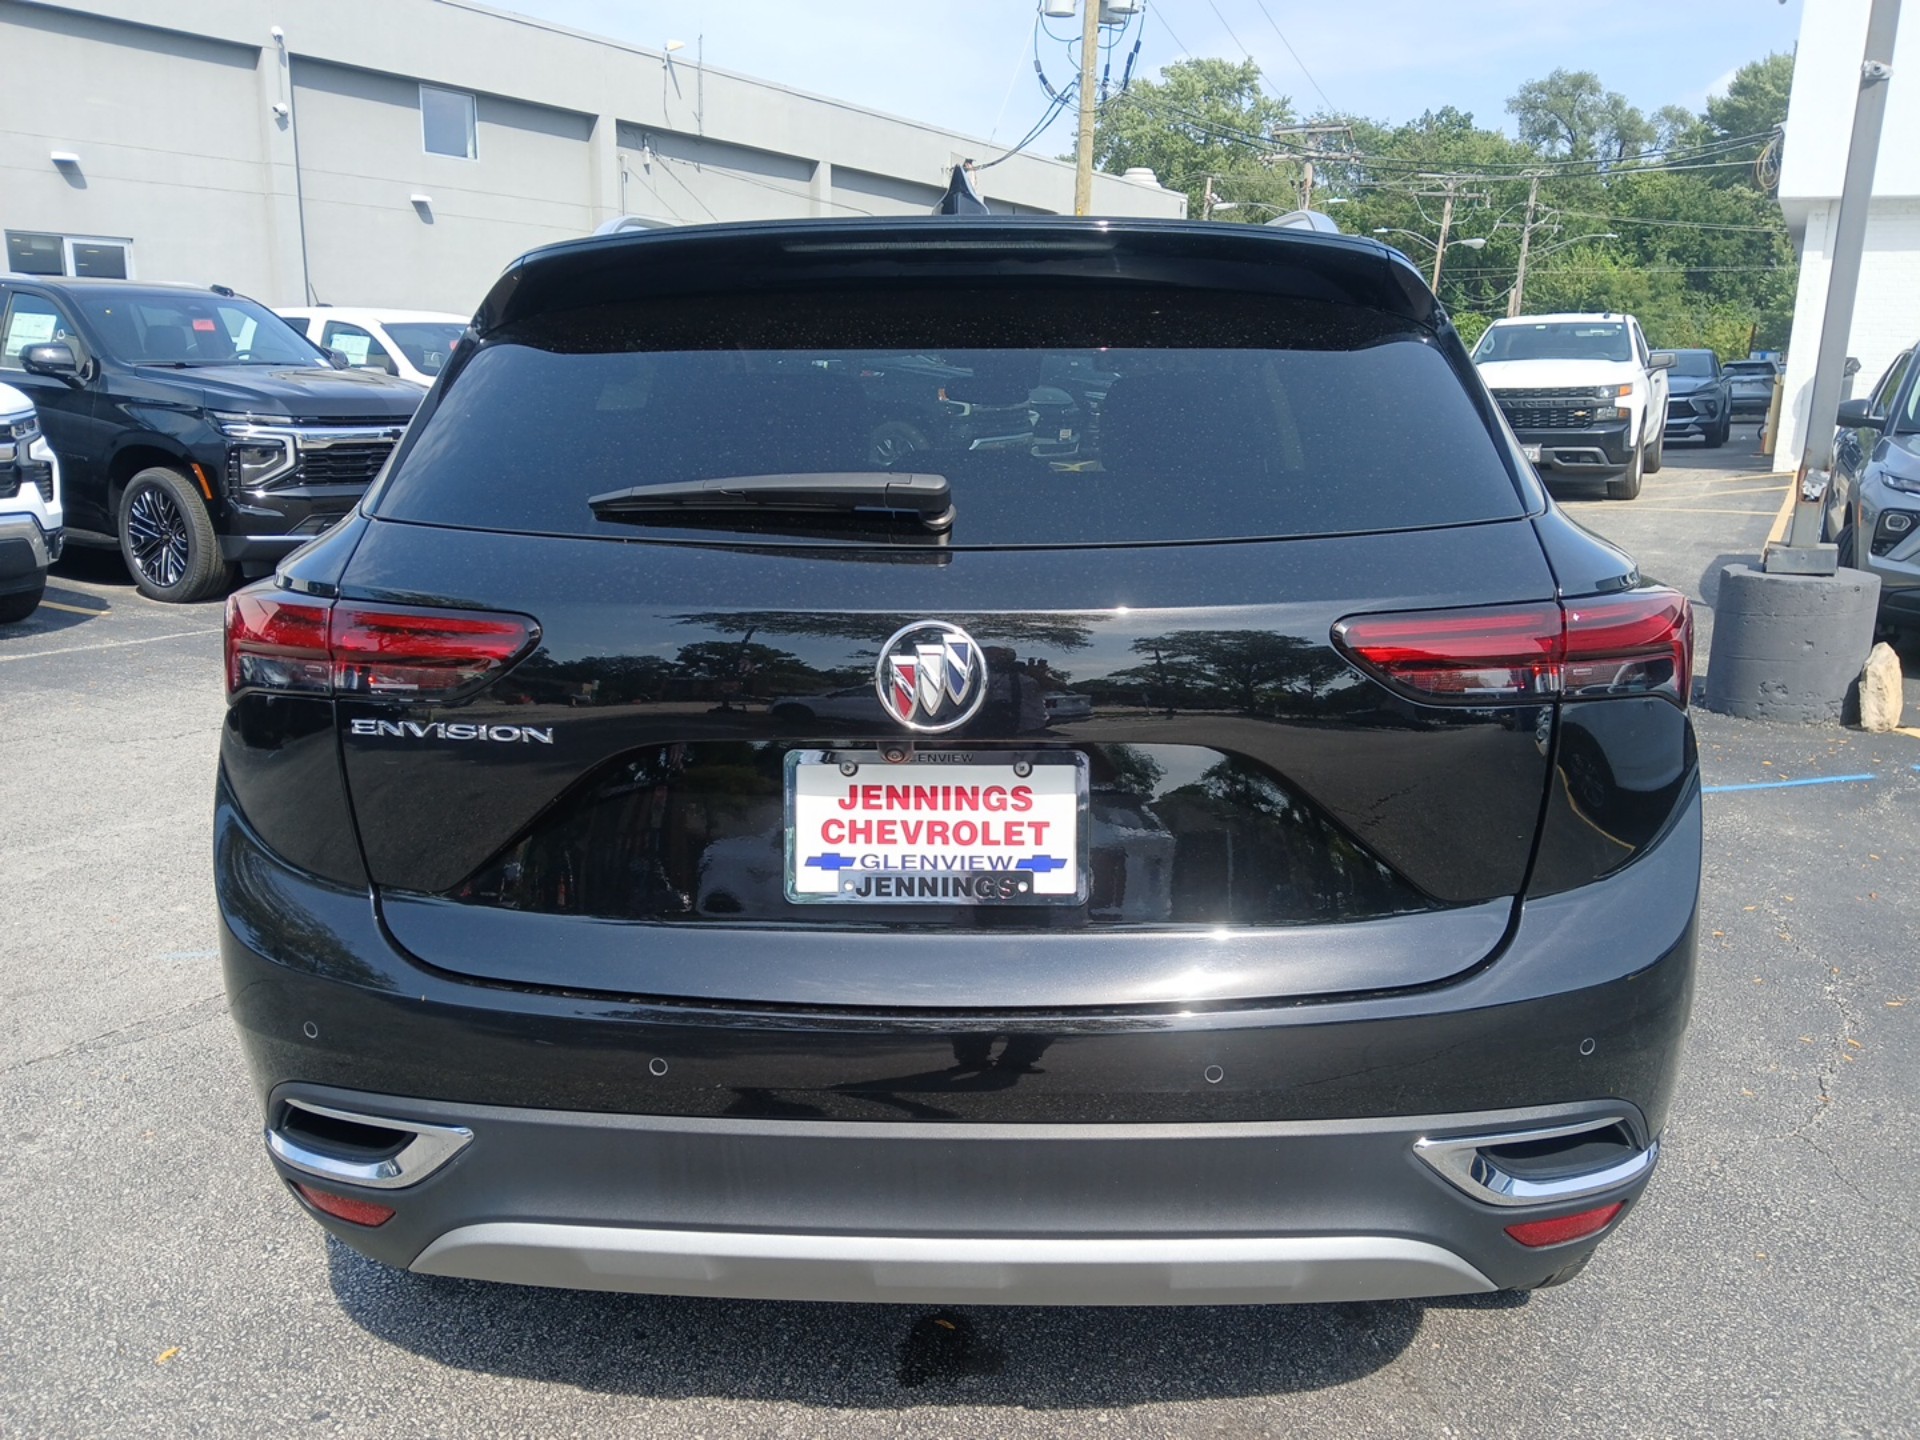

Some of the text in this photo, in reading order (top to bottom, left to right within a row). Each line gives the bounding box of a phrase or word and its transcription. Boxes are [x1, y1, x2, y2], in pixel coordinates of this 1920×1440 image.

[351, 719, 553, 744] ENVISION
[909, 753, 974, 762] ENVIEW
[838, 785, 1033, 811] JENNINGS
[821, 819, 1050, 845] CHEVROLET
[860, 854, 1013, 870] GLENVIEW
[856, 877, 1017, 898] JENNINGS
